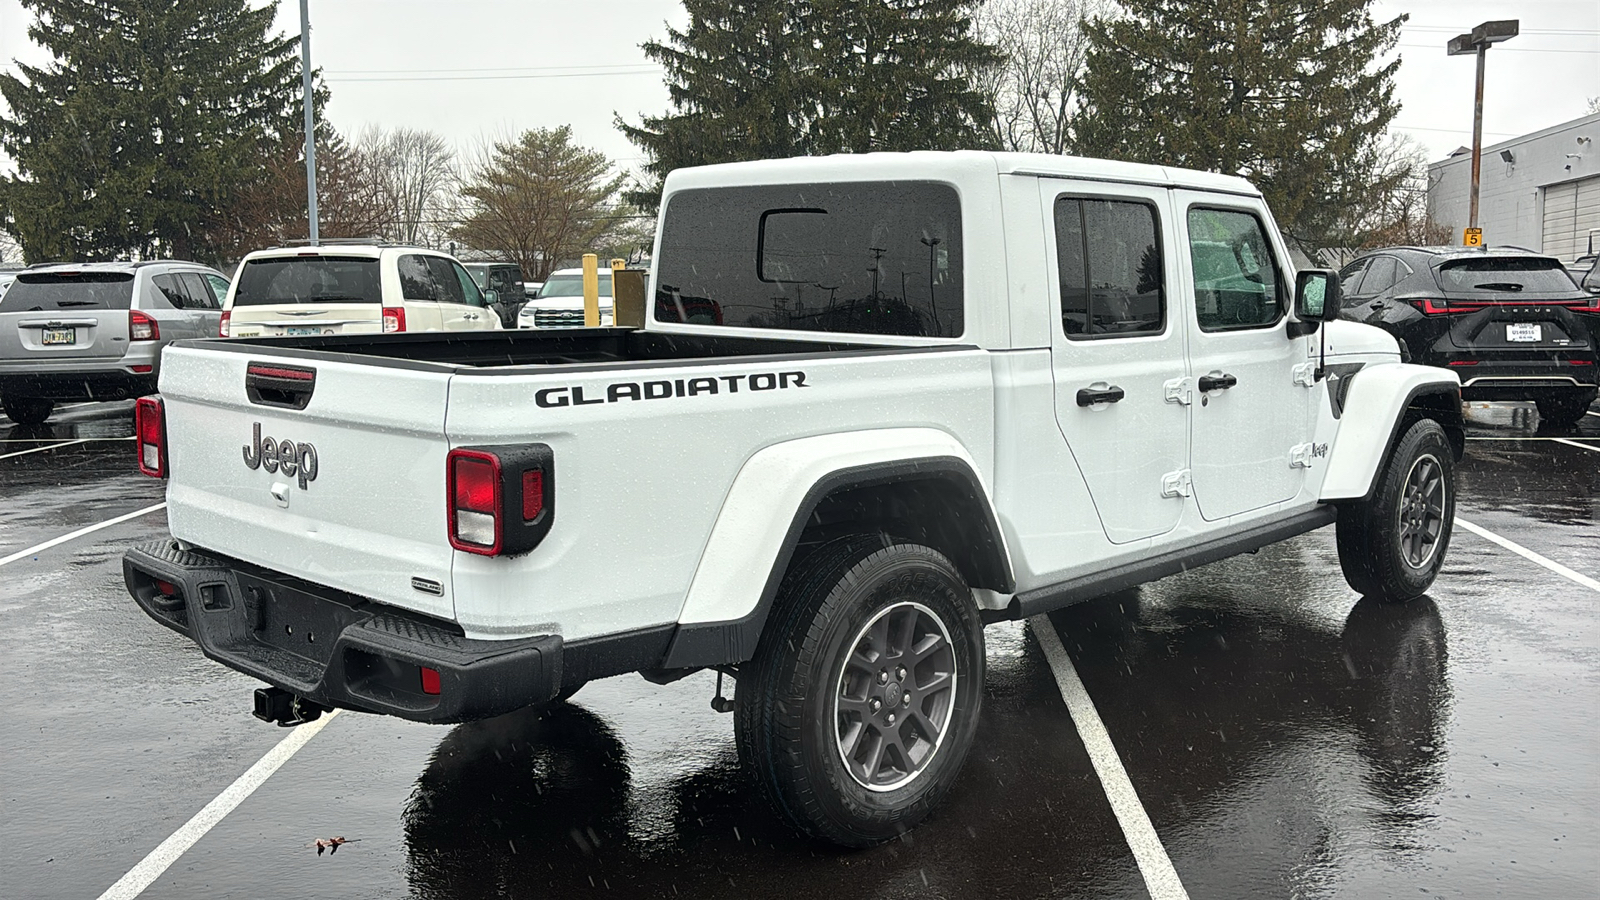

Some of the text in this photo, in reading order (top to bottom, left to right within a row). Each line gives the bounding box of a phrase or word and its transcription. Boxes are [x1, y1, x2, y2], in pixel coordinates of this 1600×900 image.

[1470, 235, 1478, 244] 5
[534, 371, 810, 408] GLADIATOR
[242, 421, 318, 490] Jeep
